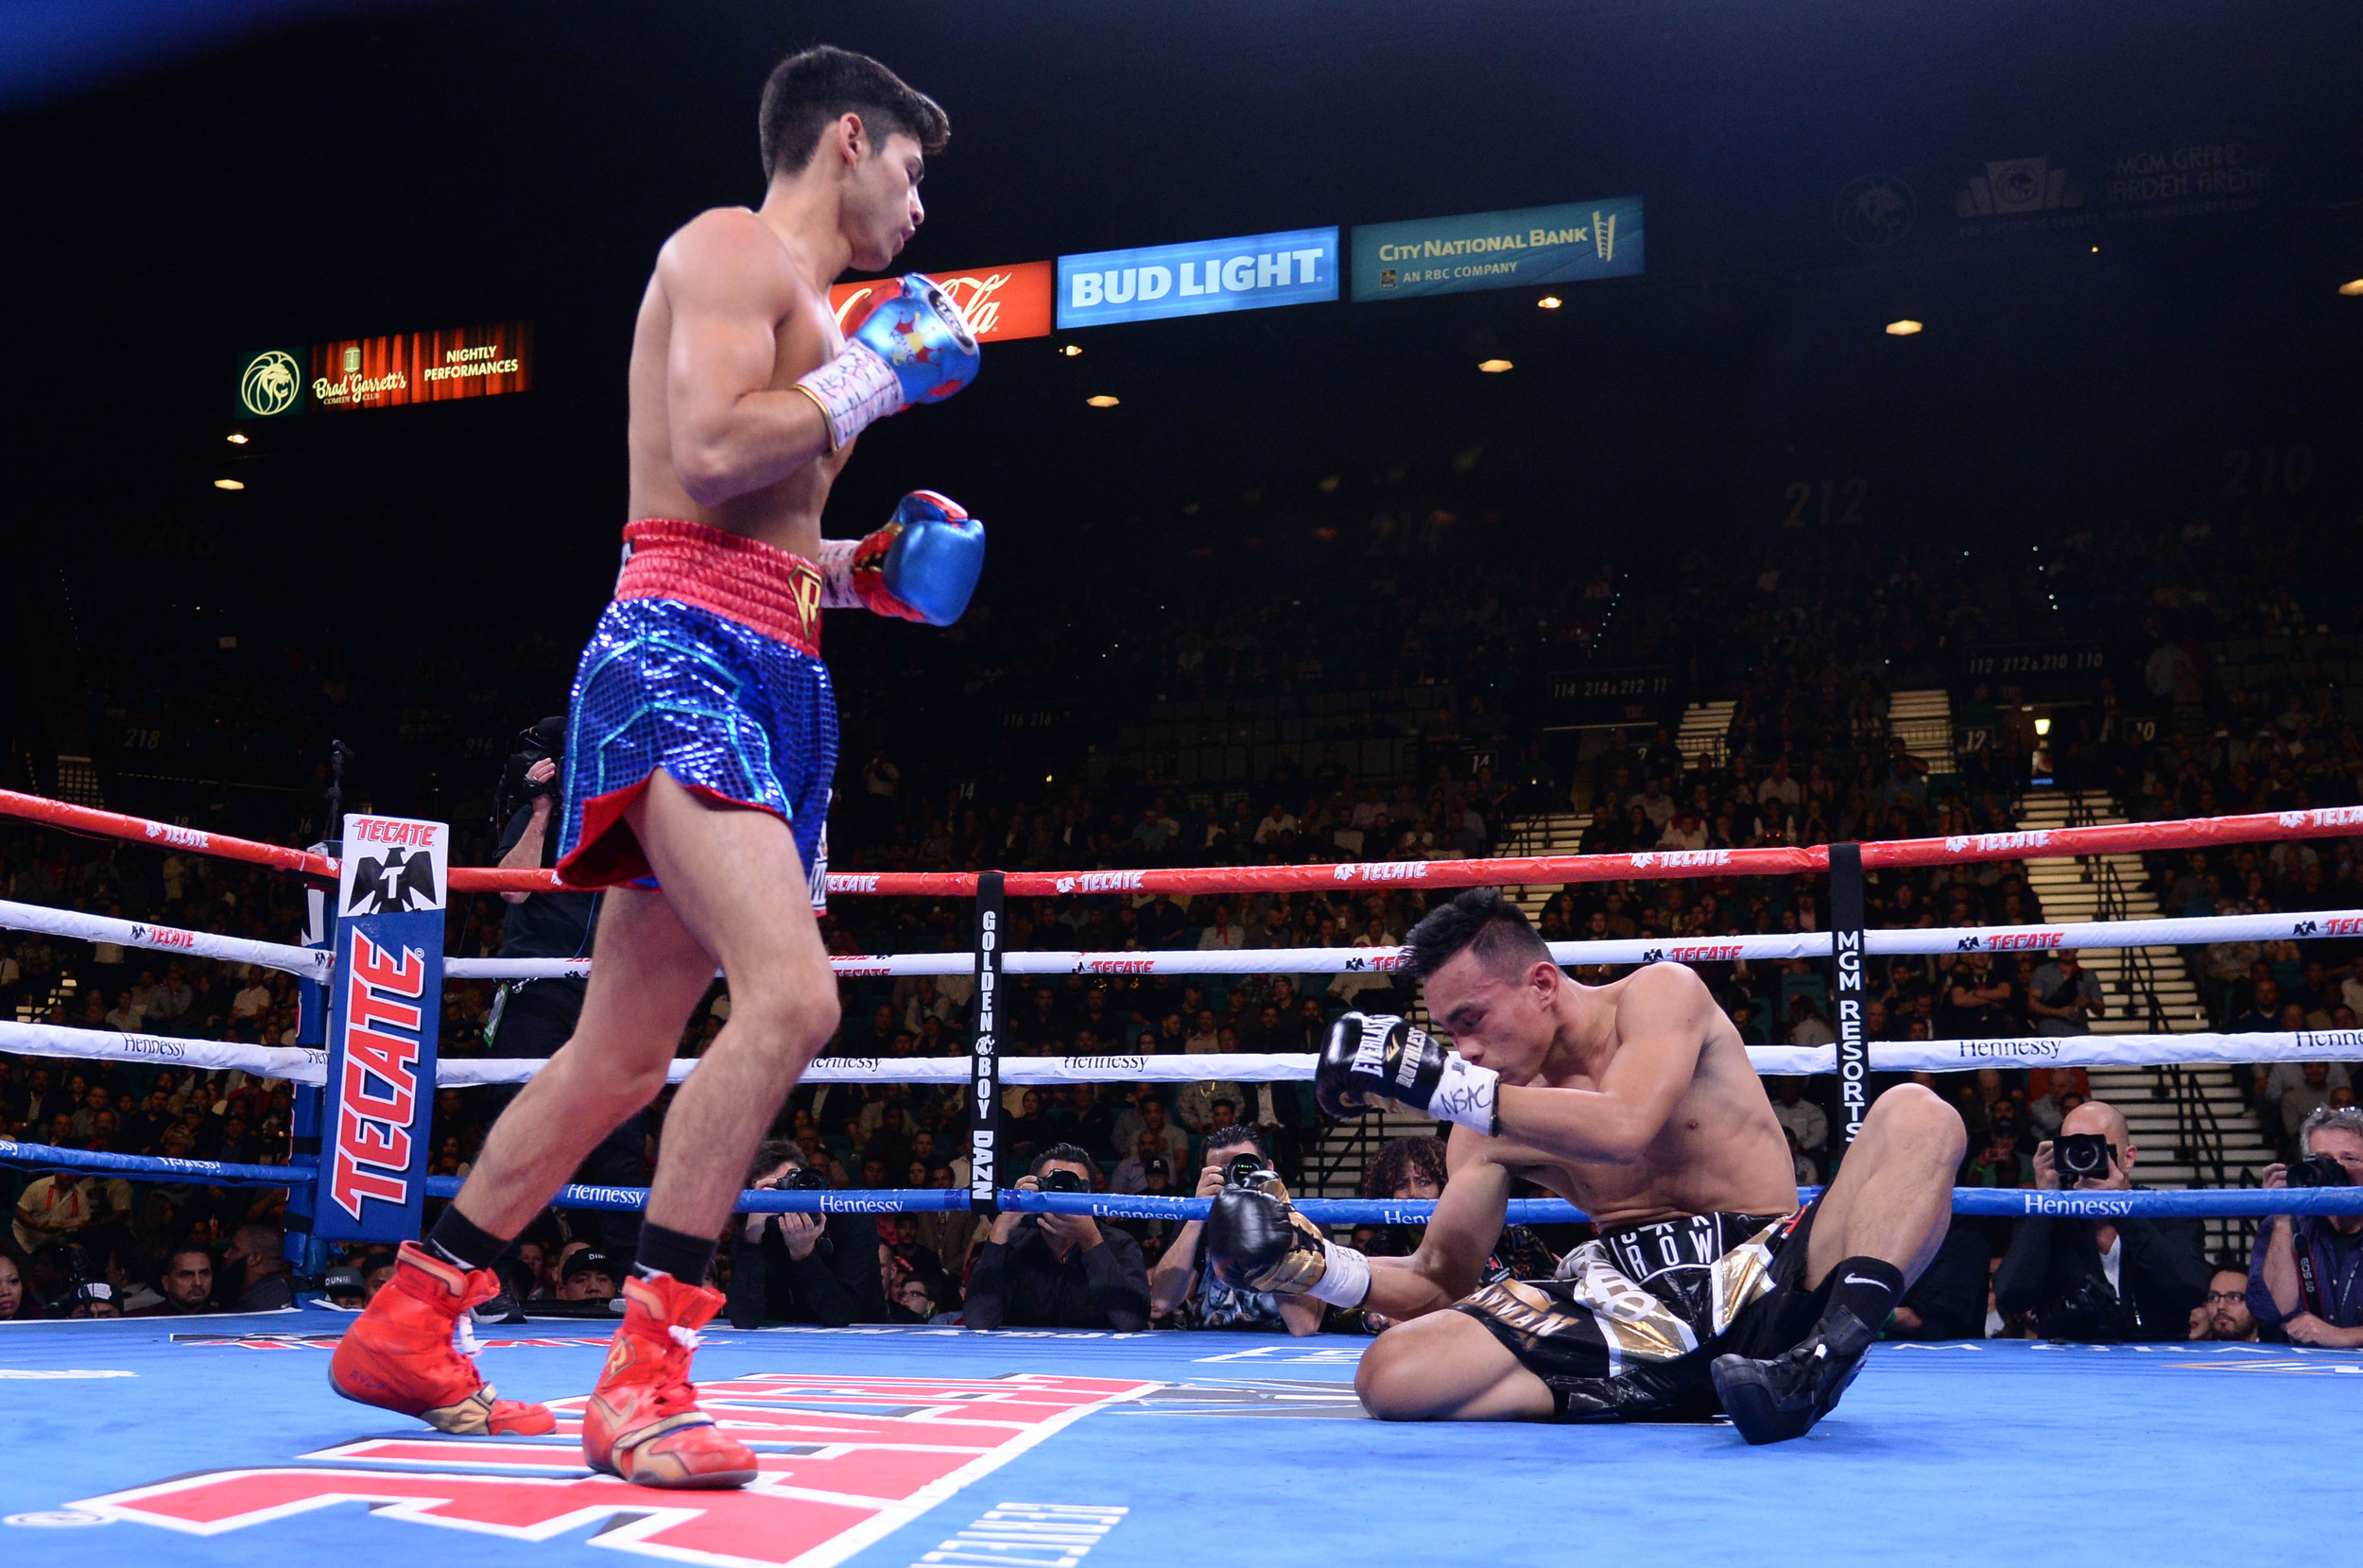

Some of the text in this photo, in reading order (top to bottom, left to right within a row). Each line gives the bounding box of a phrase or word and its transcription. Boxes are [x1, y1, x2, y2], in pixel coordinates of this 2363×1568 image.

[1379, 228, 1588, 261] CITY NATIONAL BANK
[1071, 248, 1323, 308] BUD LIGHT
[1403, 262, 1518, 283] AN RBC COMPANY
[446, 345, 497, 364] NIGHTLY
[424, 359, 519, 382] PERFORMANCES
[312, 370, 407, 404] Brad Garrett's
[323, 392, 380, 406] COMEDY CLUB
[1783, 476, 1869, 529] 212
[124, 727, 162, 750] 218
[959, 782, 975, 801] 14
[2307, 807, 2363, 827] TECA
[163, 824, 210, 849] TECATE
[353, 818, 439, 847] TECATE
[1975, 829, 2050, 853] TECATE
[1657, 850, 1732, 869] TECATE
[1078, 871, 1144, 891] TECATE
[1359, 861, 1428, 881] TECATE
[826, 874, 879, 893] TECATE
[148, 924, 194, 949] TECATE
[2322, 917, 2363, 937] TEC
[1983, 932, 2065, 951] TECATE
[1668, 945, 1744, 962] TECATE
[1837, 930, 1860, 991] MGM
[1088, 960, 1155, 974] TECATE
[976, 910, 996, 1120] GOLDEN BOY
[122, 1033, 185, 1059] Hennessy
[1960, 1040, 2062, 1058] Hennessy
[331, 924, 424, 1221] TECATE
[1440, 1083, 1492, 1115] NSAC
[973, 1129, 994, 1200] DAZN
[567, 1183, 645, 1205] Hennessy
[819, 1195, 904, 1213] Hennessy
[2025, 1194, 2133, 1216] Hennessy
[1625, 1228, 1713, 1280] ROW
[2301, 1257, 2312, 1279] EOS
[908, 1501, 1130, 1568] CERVEZ
